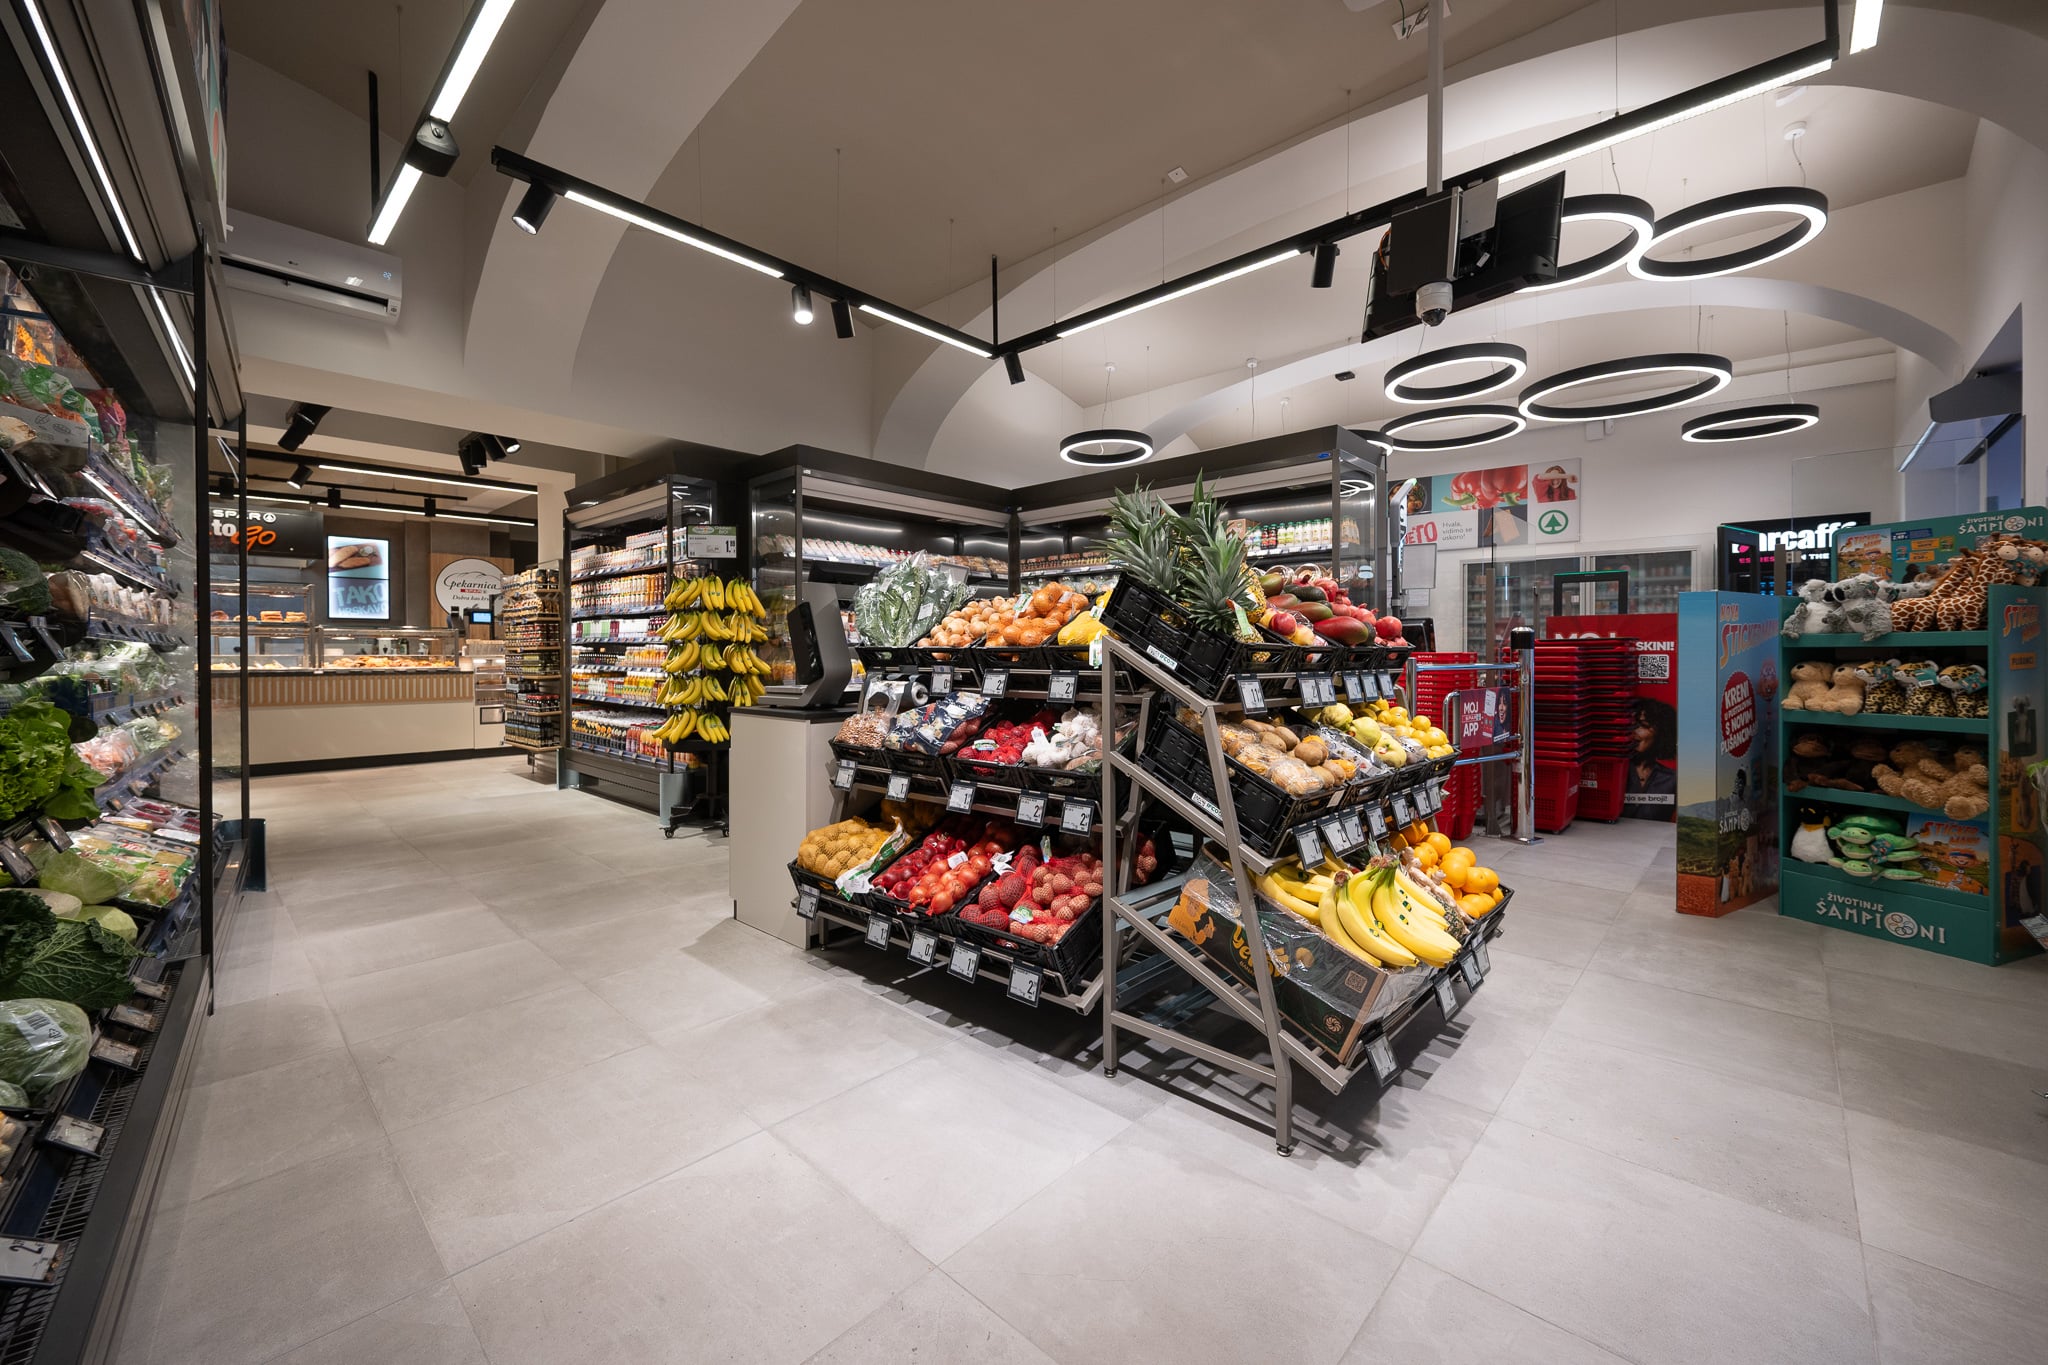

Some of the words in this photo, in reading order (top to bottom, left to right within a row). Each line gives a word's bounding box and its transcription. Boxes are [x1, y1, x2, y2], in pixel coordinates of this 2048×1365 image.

[332, 582, 385, 607] TAKO
[1635, 641, 1674, 651] SKINI!
[1724, 680, 1750, 709] KRENI
[1463, 701, 1479, 714] MOJ
[1463, 722, 1479, 738] APP
[1725, 721, 1730, 736] S
[1731, 708, 1753, 731] NOVIM
[1827, 891, 1885, 912] ŽIVOTINJE
